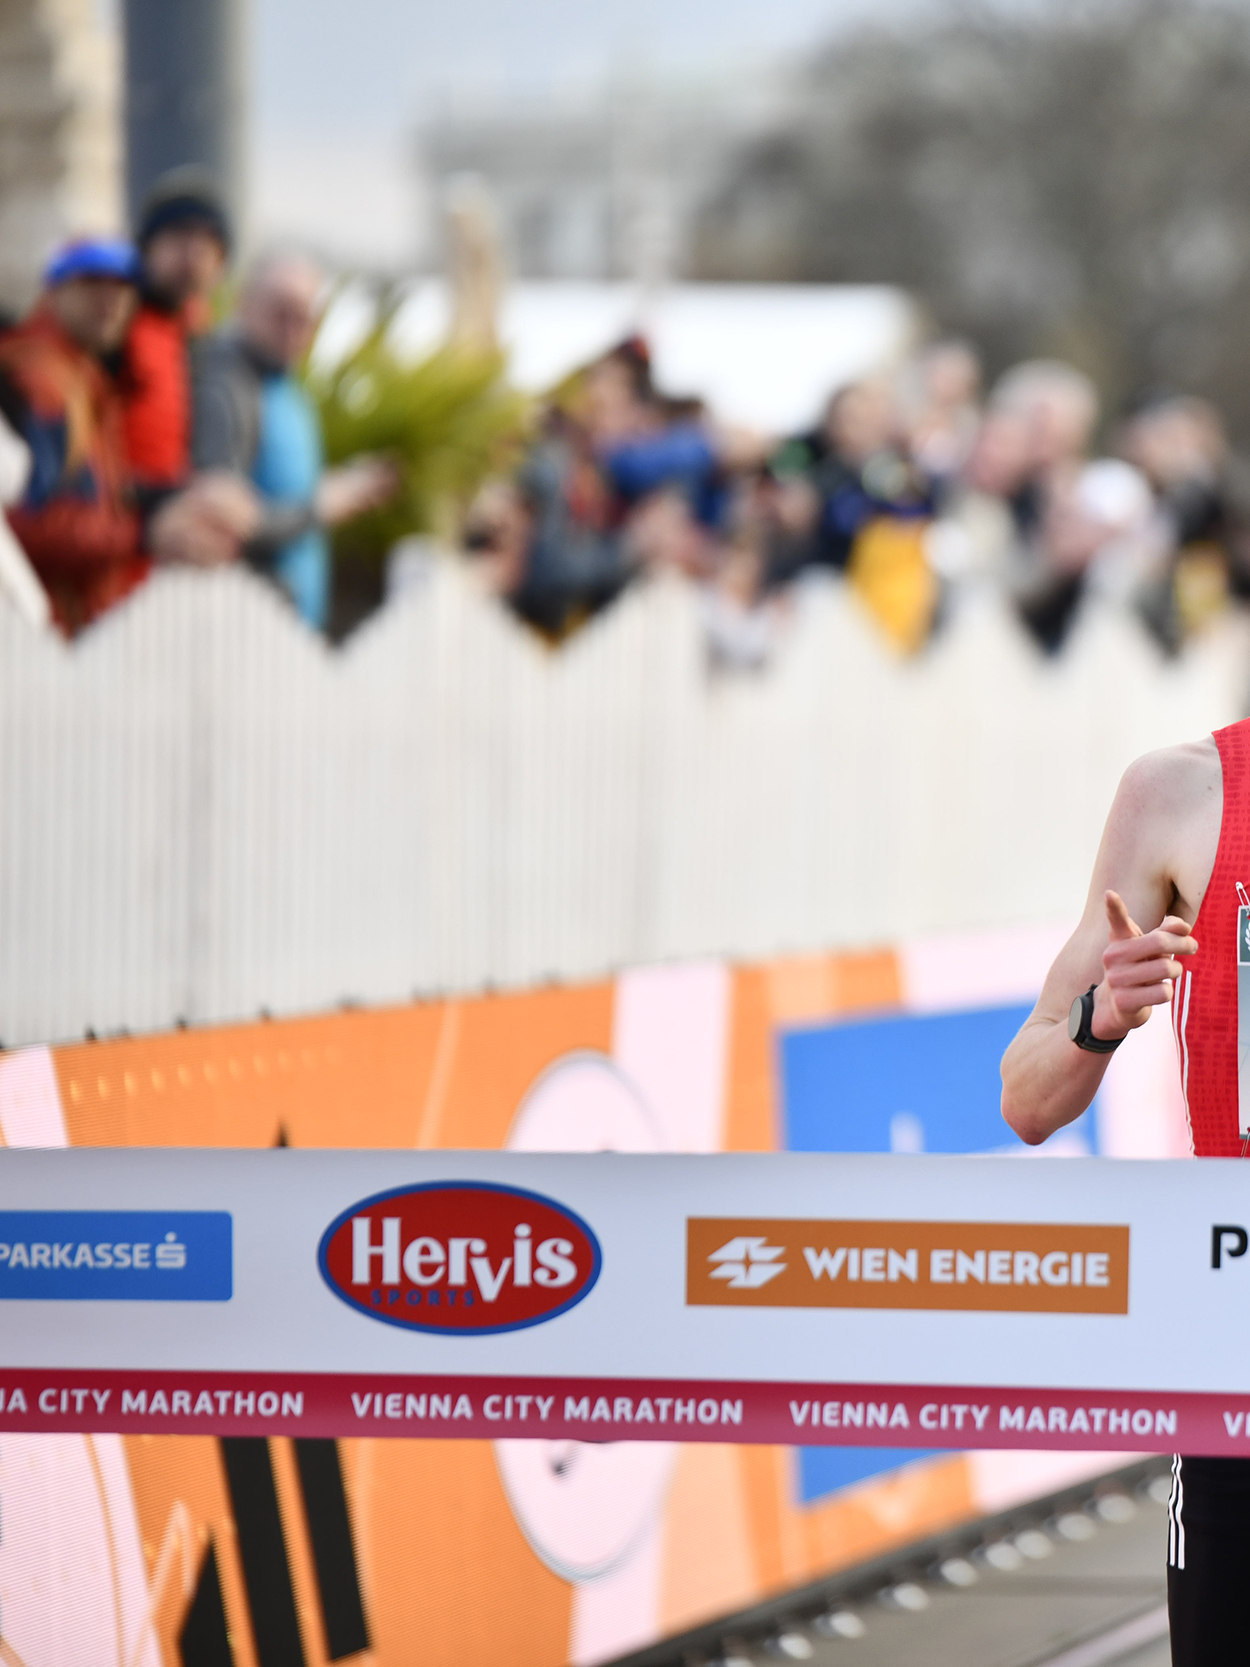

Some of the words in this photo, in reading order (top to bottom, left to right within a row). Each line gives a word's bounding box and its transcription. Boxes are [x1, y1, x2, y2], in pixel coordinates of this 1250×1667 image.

[351, 1216, 578, 1303] Hervis
[802, 1246, 918, 1283] WIEN
[929, 1249, 1110, 1288] ENERGIE
[370, 1289, 475, 1307] SPORTS
[37, 1388, 112, 1415] CITY
[120, 1389, 305, 1418] MARATHON
[351, 1392, 474, 1420] VIENNA
[482, 1394, 556, 1422] CITY
[563, 1396, 744, 1425] MARATHON
[788, 1400, 911, 1429] VIENNA
[918, 1403, 991, 1431] CITY
[999, 1405, 1179, 1438] MARATHON
